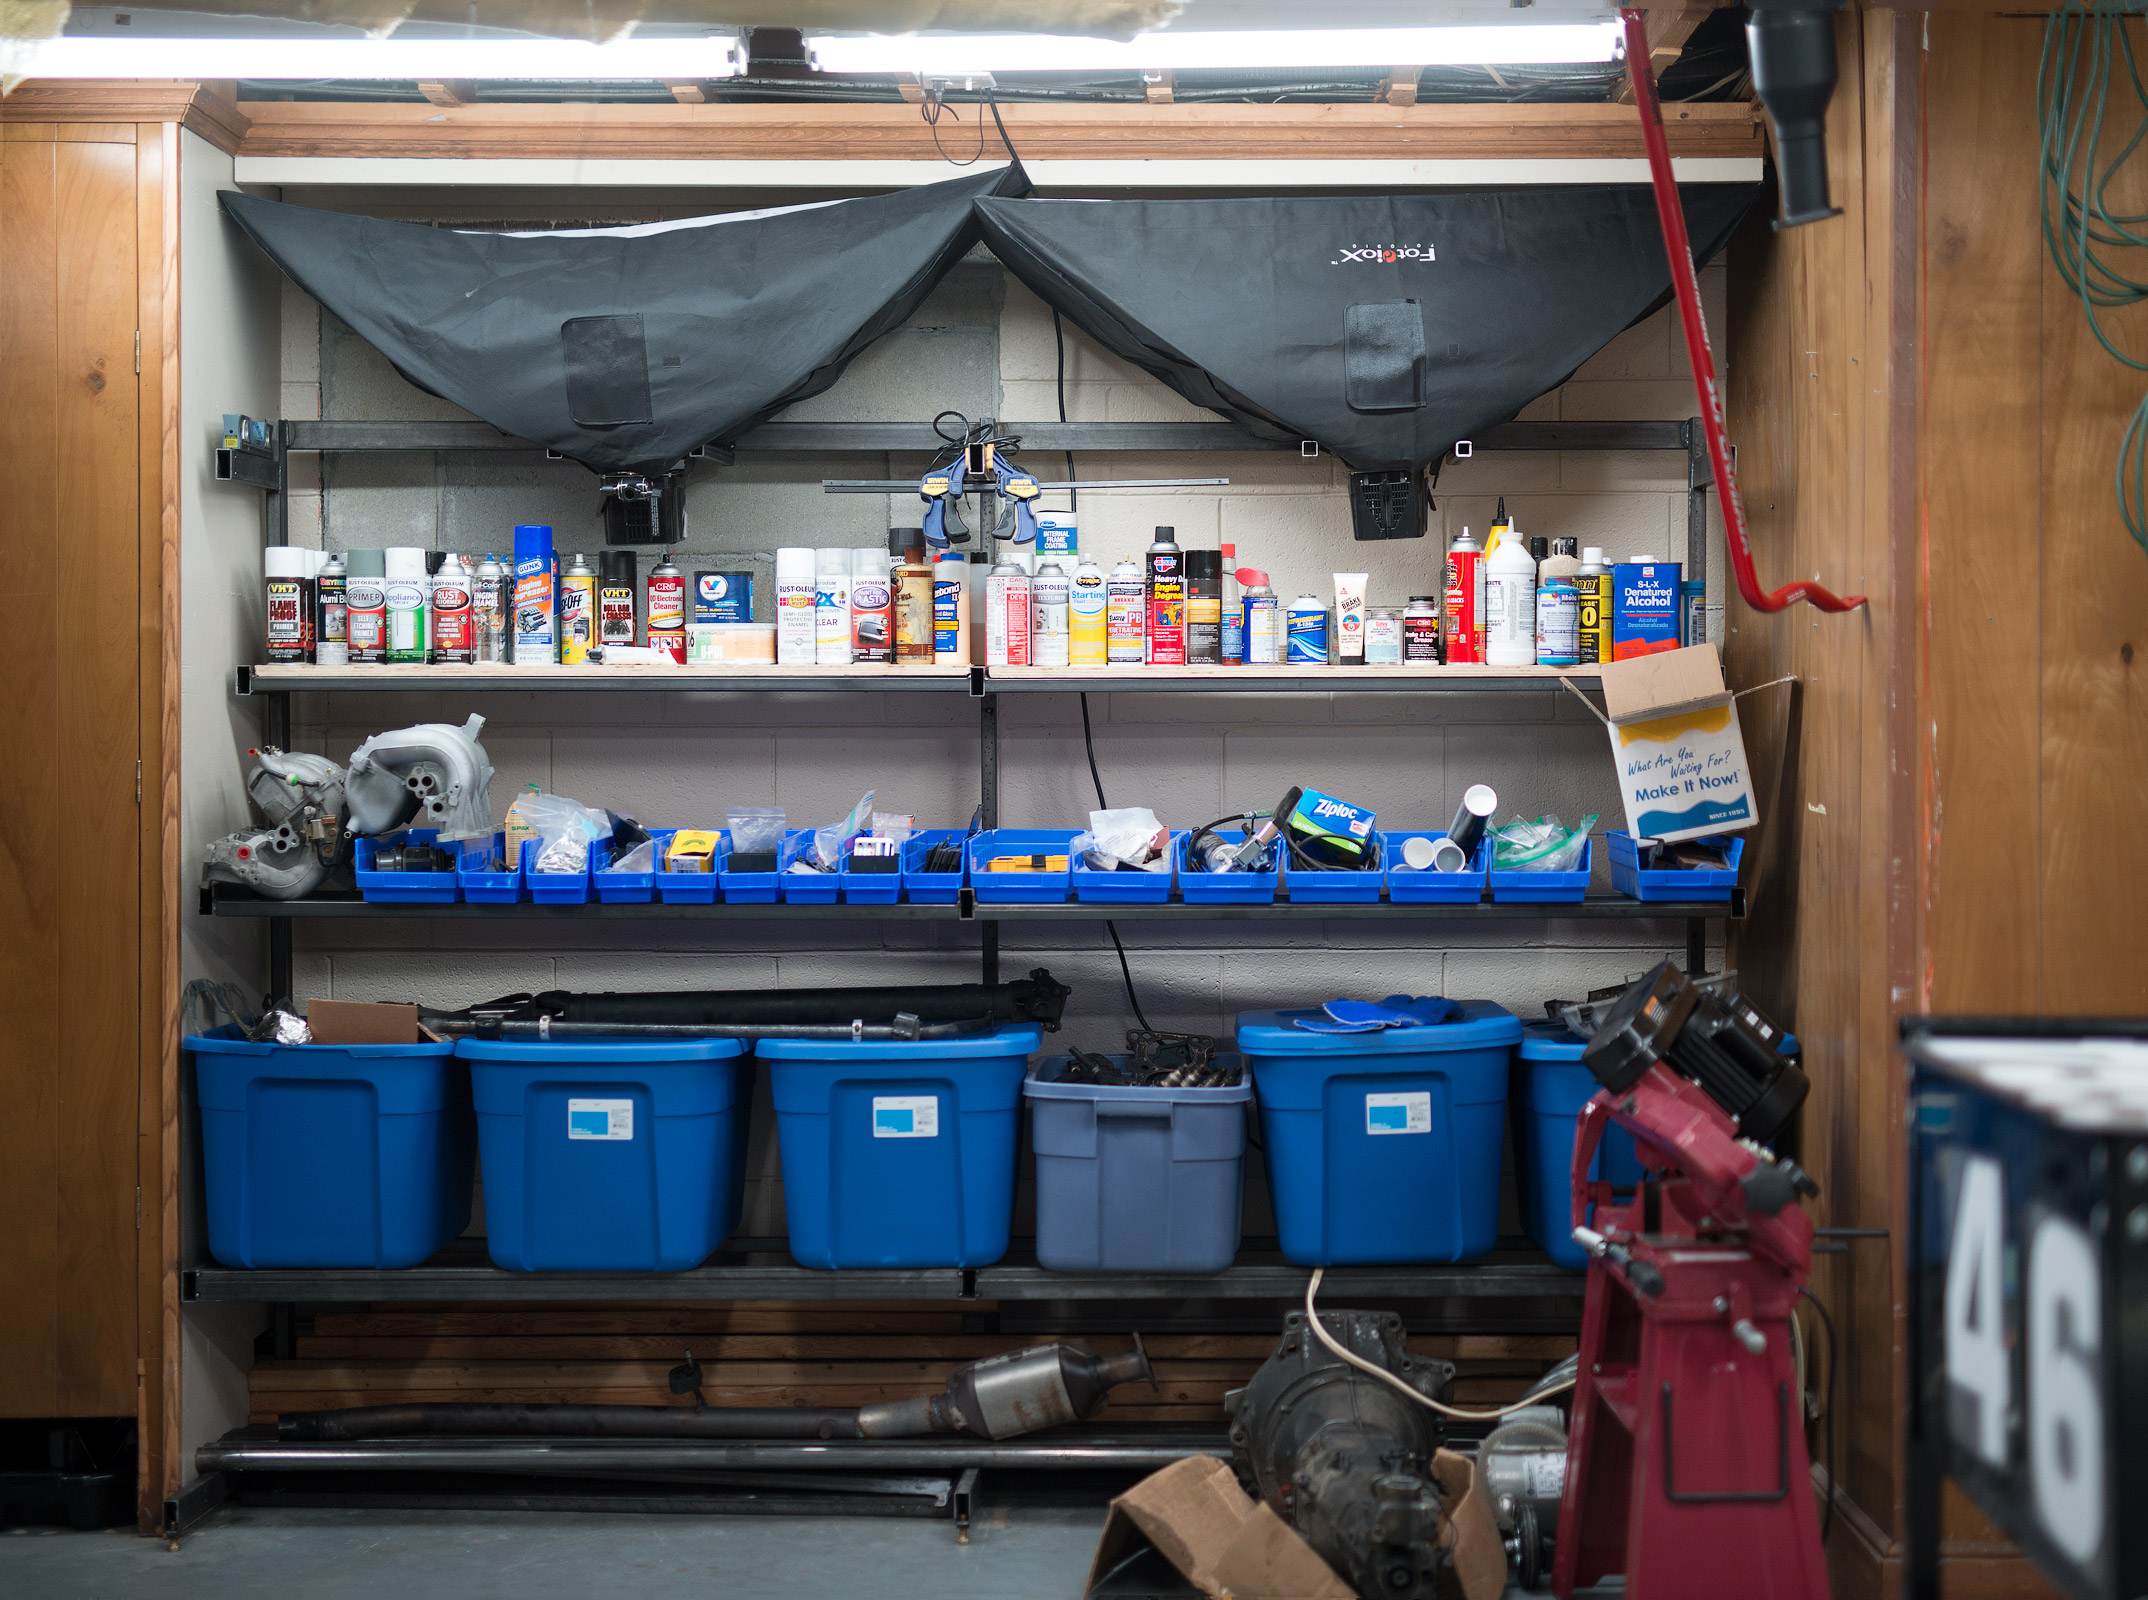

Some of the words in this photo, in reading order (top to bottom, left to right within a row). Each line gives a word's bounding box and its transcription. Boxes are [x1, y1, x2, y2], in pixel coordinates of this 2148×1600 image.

[519, 561, 541, 573] GUNK
[1154, 575, 1178, 584] Heavy
[1638, 580, 1660, 588] S-L-X
[270, 584, 296, 593] VHT
[518, 580, 542, 593] Engine
[1154, 583, 1181, 593] Engine
[437, 591, 459, 599] RUST
[473, 592, 499, 600] ENGINE
[604, 589, 629, 597] VHT
[1071, 590, 1105, 601] Starting
[1625, 588, 1673, 597] Denatured
[348, 593, 380, 602] PRIMER
[657, 594, 683, 602] Electronic
[855, 595, 887, 604] PLASTIC
[1626, 596, 1671, 607] Alcohol
[270, 600, 297, 610] FLAME
[473, 599, 499, 607] ENAMEL
[653, 602, 678, 610] Cleaner
[1342, 596, 1361, 610] BRAKE
[270, 610, 297, 620] PROOF
[1129, 612, 1142, 624] PB
[1628, 760, 1652, 777] What
[1655, 753, 1673, 769] Are
[1678, 747, 1694, 762] You
[1670, 762, 1703, 779] Waiting
[1707, 750, 1732, 768] For?
[1635, 784, 1680, 803] Make
[1684, 778, 1695, 793] It
[1699, 771, 1740, 791] Now!
[1313, 798, 1358, 820] Ziploc
[1709, 811, 1727, 820] SINCE
